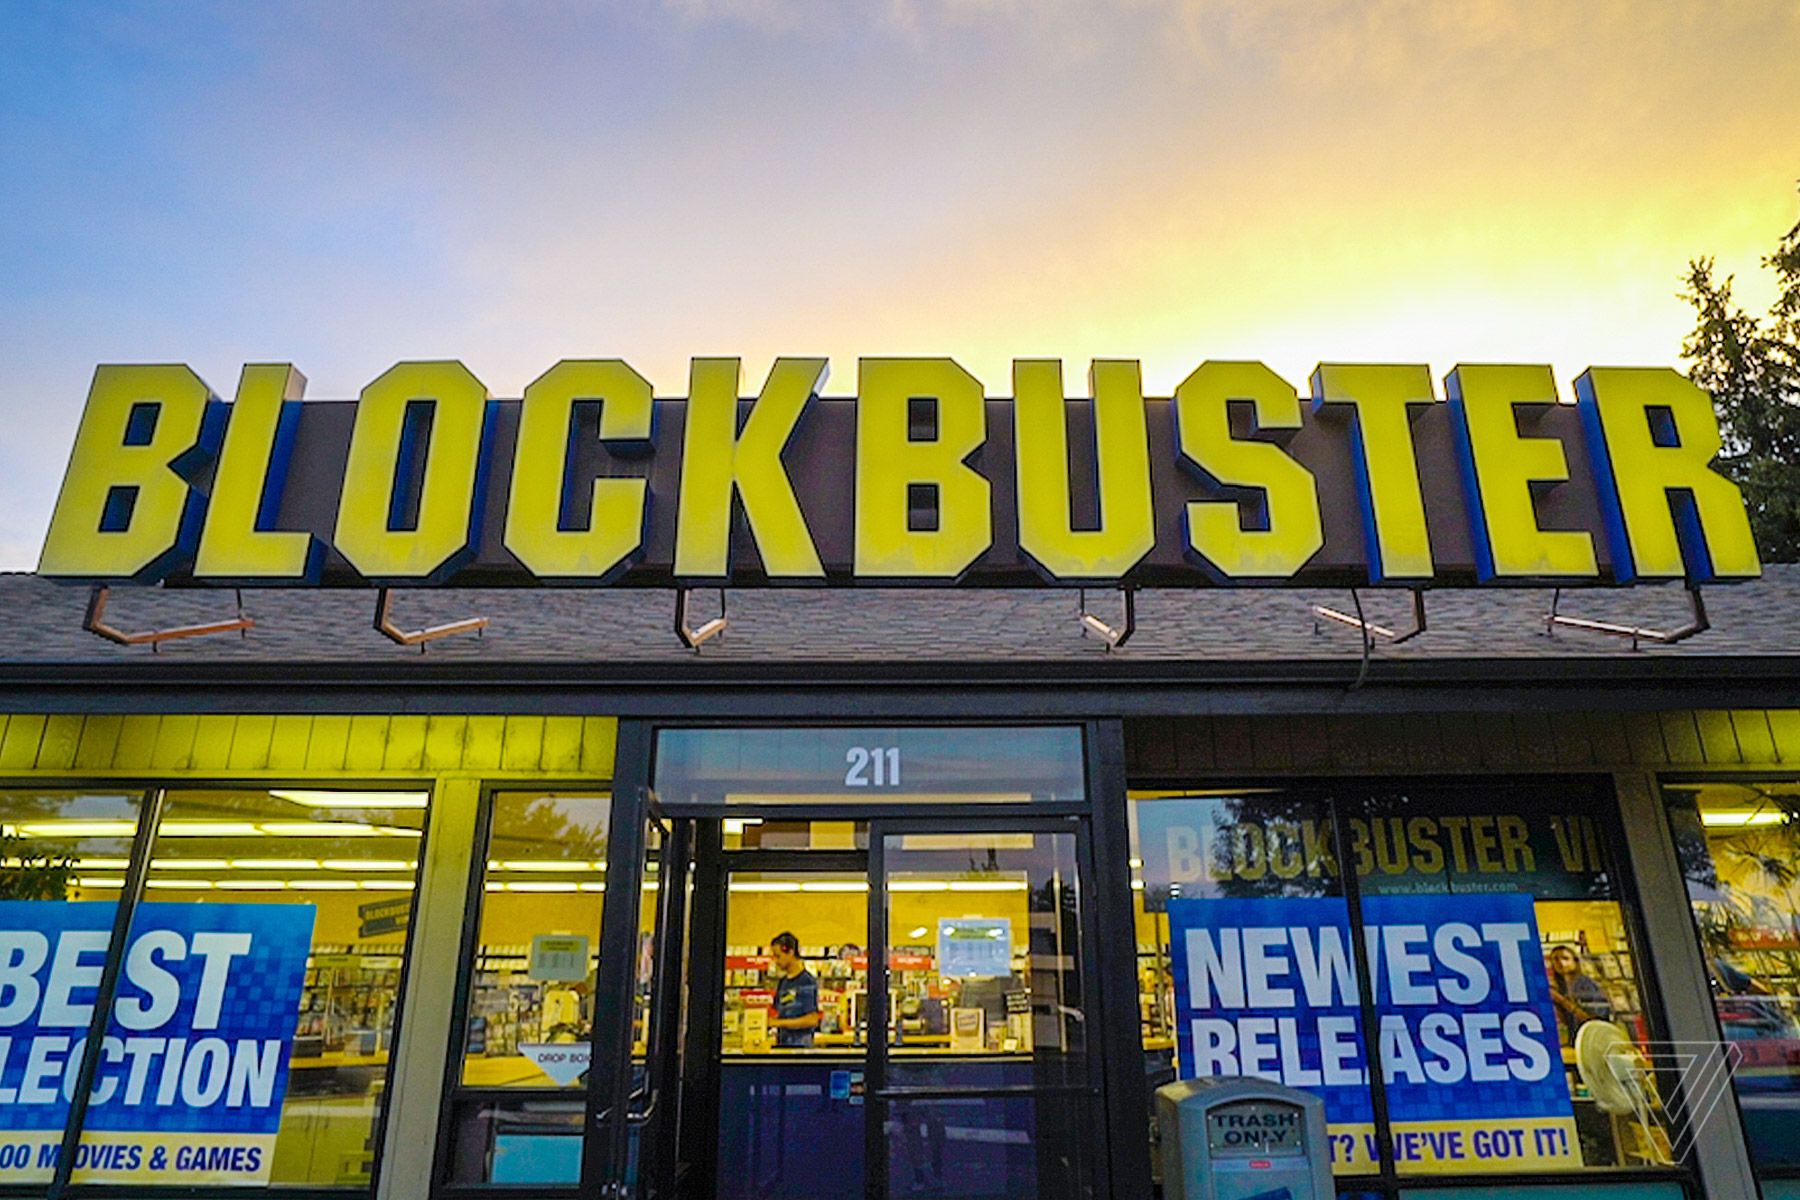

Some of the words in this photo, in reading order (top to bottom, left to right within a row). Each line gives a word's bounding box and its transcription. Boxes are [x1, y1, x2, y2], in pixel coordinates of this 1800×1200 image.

[36, 357, 1762, 579] BLOCKBUSTER
[845, 747, 899, 786] 211
[1166, 815, 1536, 883] BLOCKBUSTER
[0, 931, 251, 1030] BEST
[1185, 923, 1531, 1010] NEWEST
[1191, 1010, 1552, 1087] RELEASES
[1212, 1113, 1294, 1128] TRASH
[1224, 1130, 1287, 1144] ONLY
[1365, 1131, 1466, 1163] WE'VE
[1473, 1129, 1524, 1160] GOT
[1533, 1128, 1569, 1156] IT!
[37, 1144, 143, 1171] MOVIES
[149, 1146, 168, 1171] &
[175, 1147, 262, 1172] GAMES
